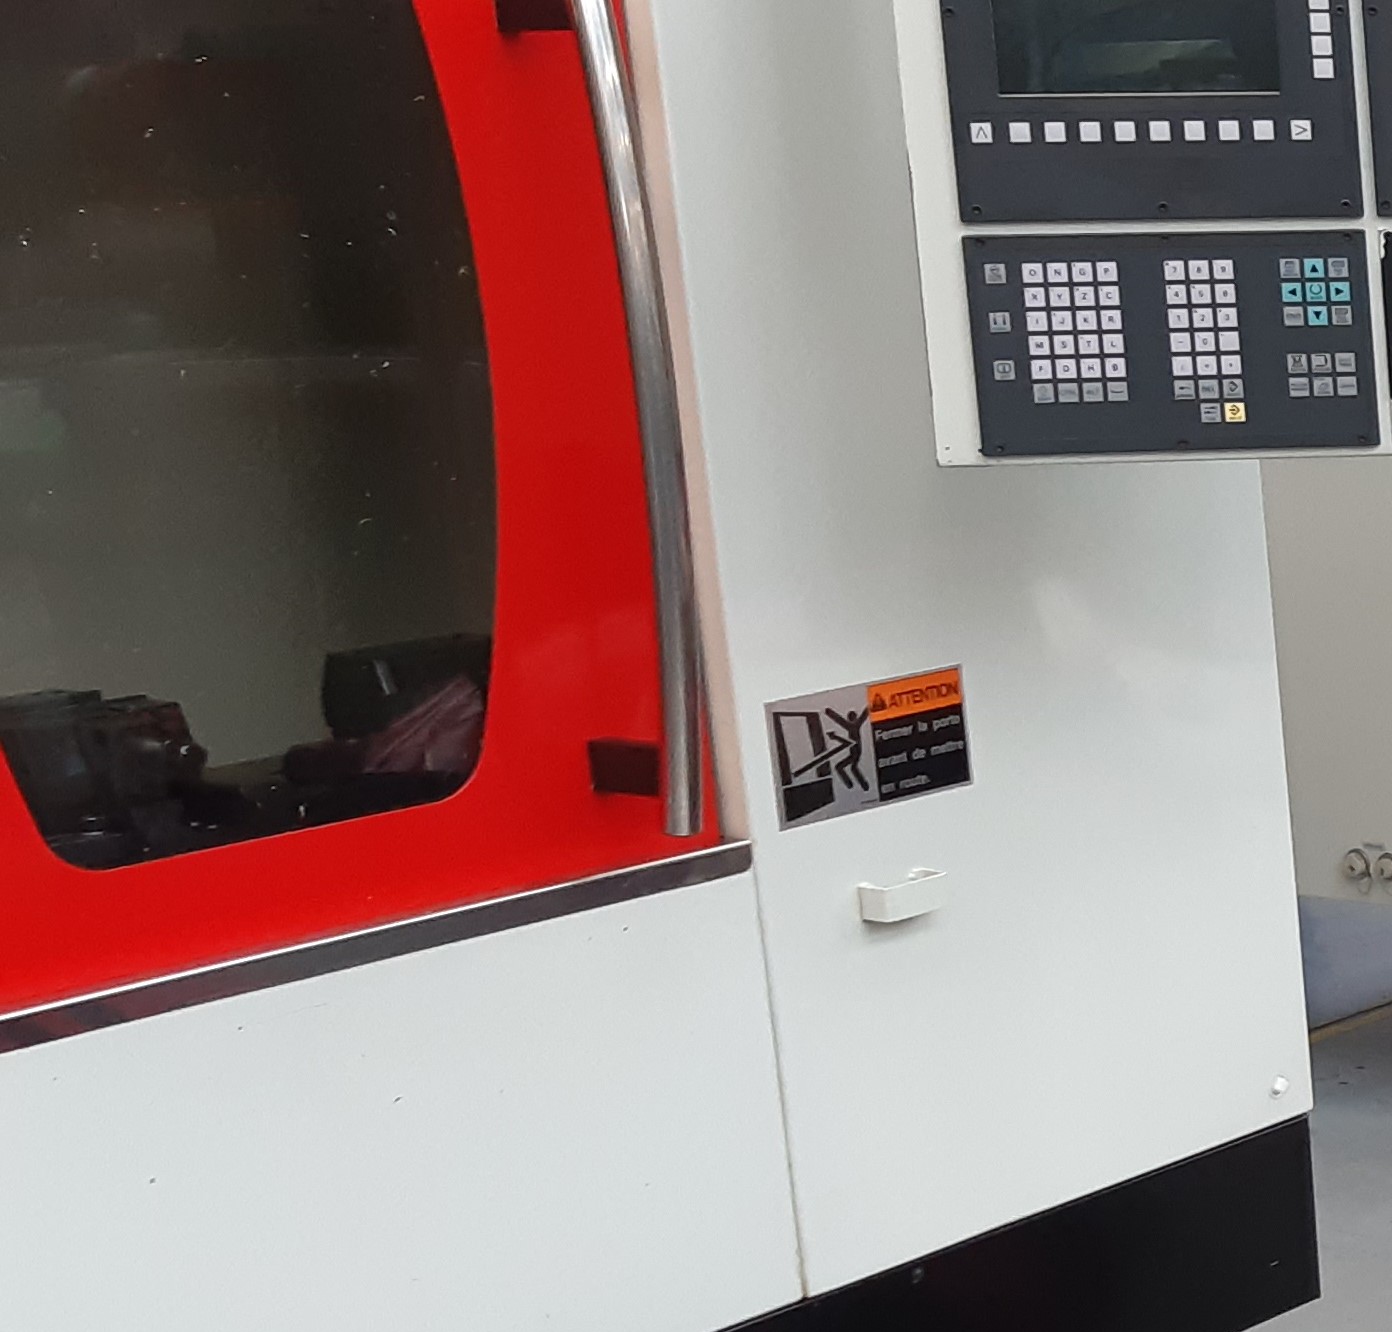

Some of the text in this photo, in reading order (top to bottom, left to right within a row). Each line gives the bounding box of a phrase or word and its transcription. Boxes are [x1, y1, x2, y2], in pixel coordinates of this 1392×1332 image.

[888, 681, 960, 708] ATTENTION
[875, 715, 961, 741] Fermer la porte
[878, 752, 908, 768] avant
[912, 747, 926, 760] de
